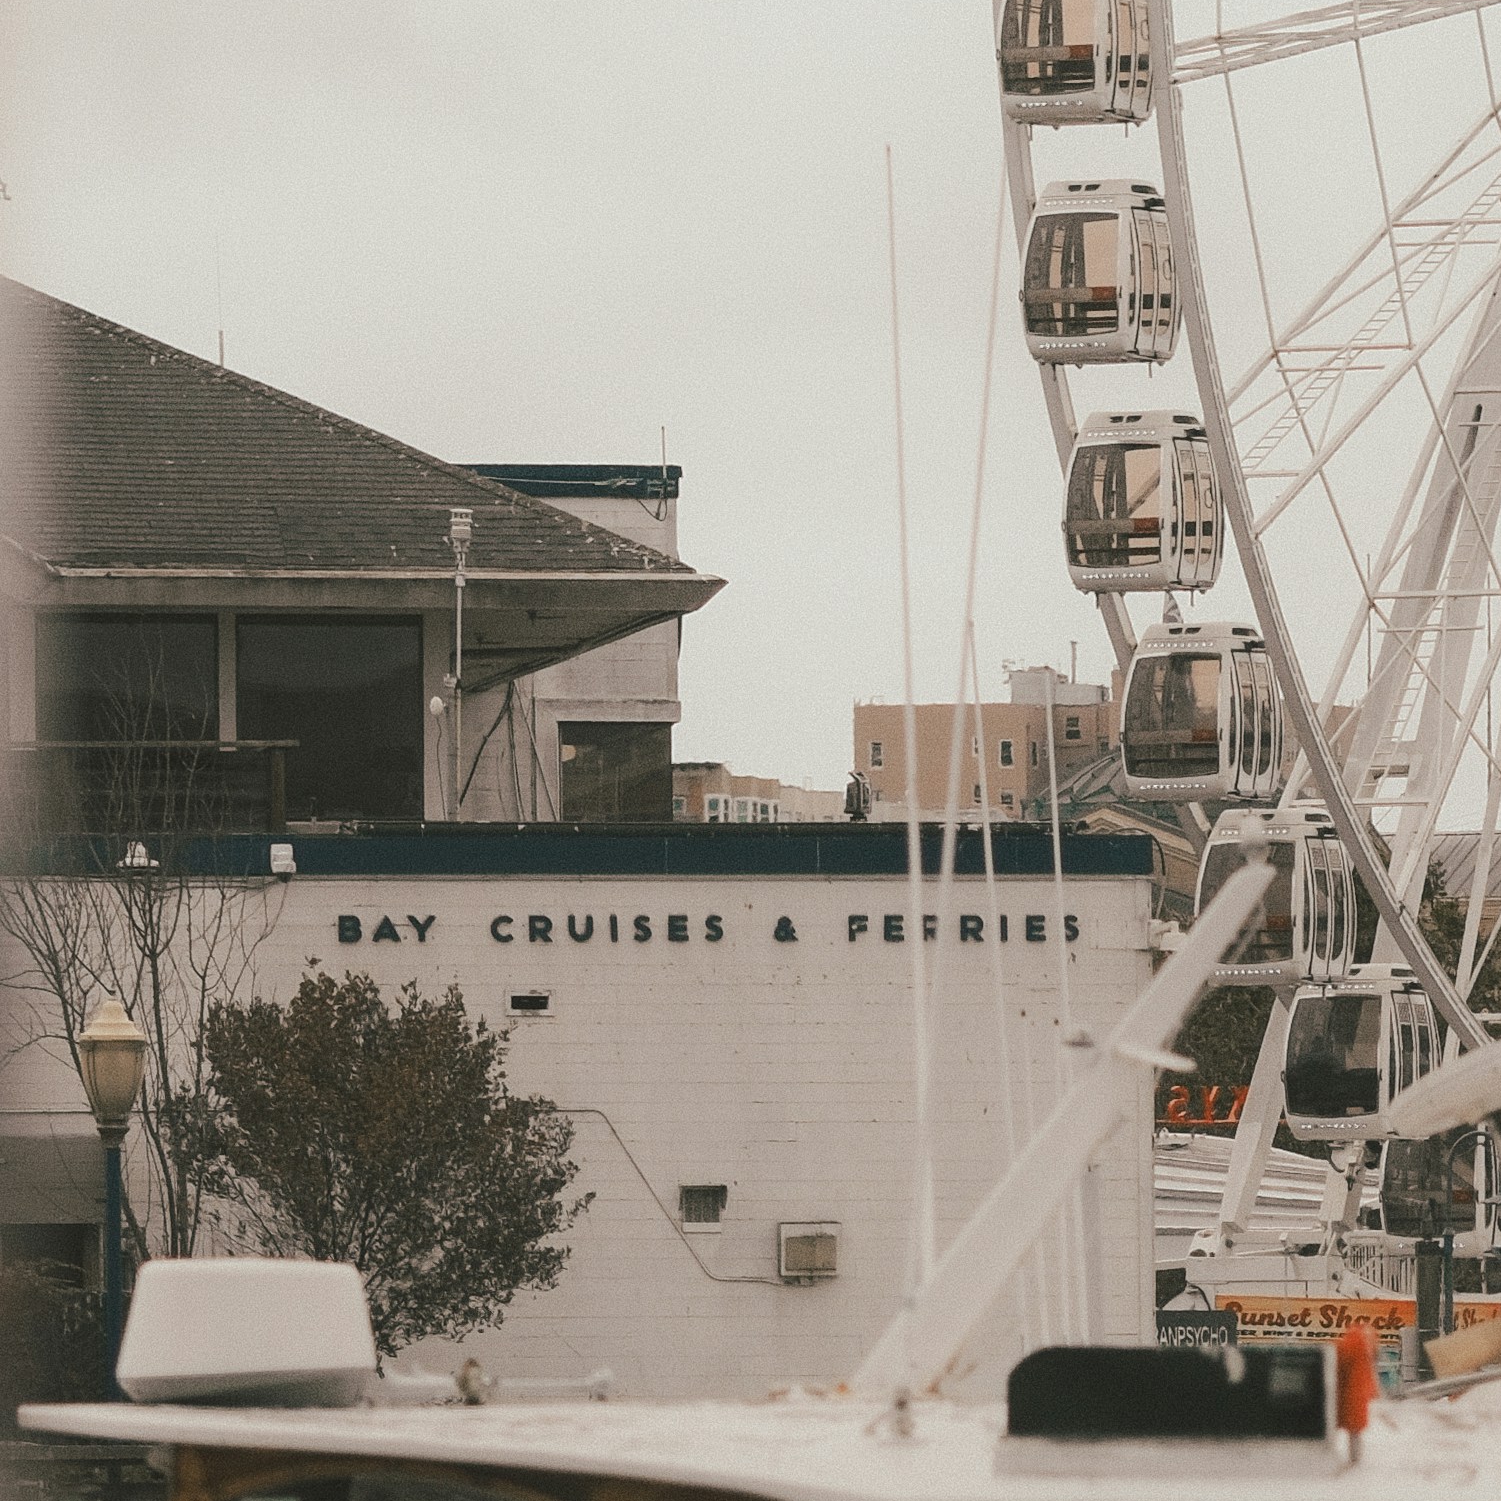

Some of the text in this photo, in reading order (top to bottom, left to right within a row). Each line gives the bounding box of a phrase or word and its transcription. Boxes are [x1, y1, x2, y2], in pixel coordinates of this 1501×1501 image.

[338, 913, 1080, 943] BAY CRUISES & FERRIES
[1319, 1305, 1406, 1330] Shack
[1155, 1325, 1228, 1347] ANPSYCHO
